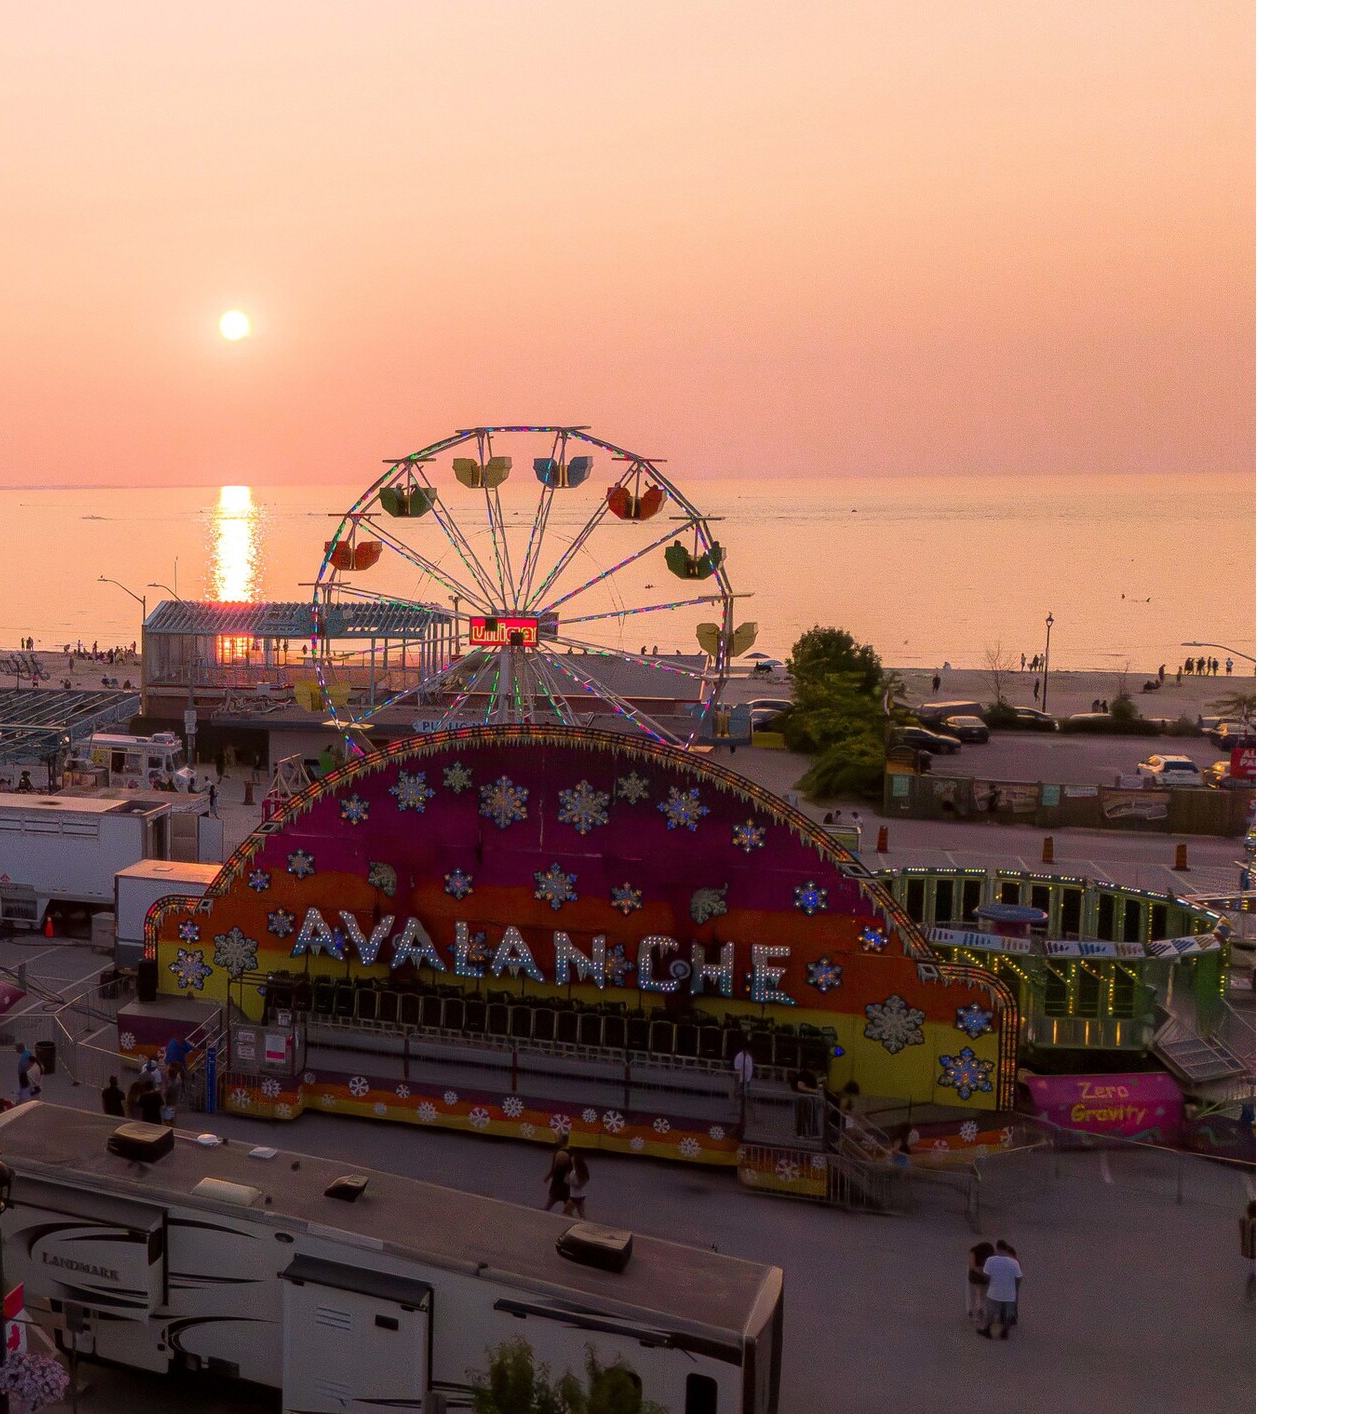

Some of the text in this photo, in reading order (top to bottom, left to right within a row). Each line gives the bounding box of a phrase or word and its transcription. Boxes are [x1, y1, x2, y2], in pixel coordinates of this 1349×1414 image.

[290, 906, 798, 1006] AVALANCHE
[1077, 1082, 1129, 1098] Zero
[1071, 1103, 1146, 1125] Gravity
[42, 1251, 120, 1281] LANDMARK
